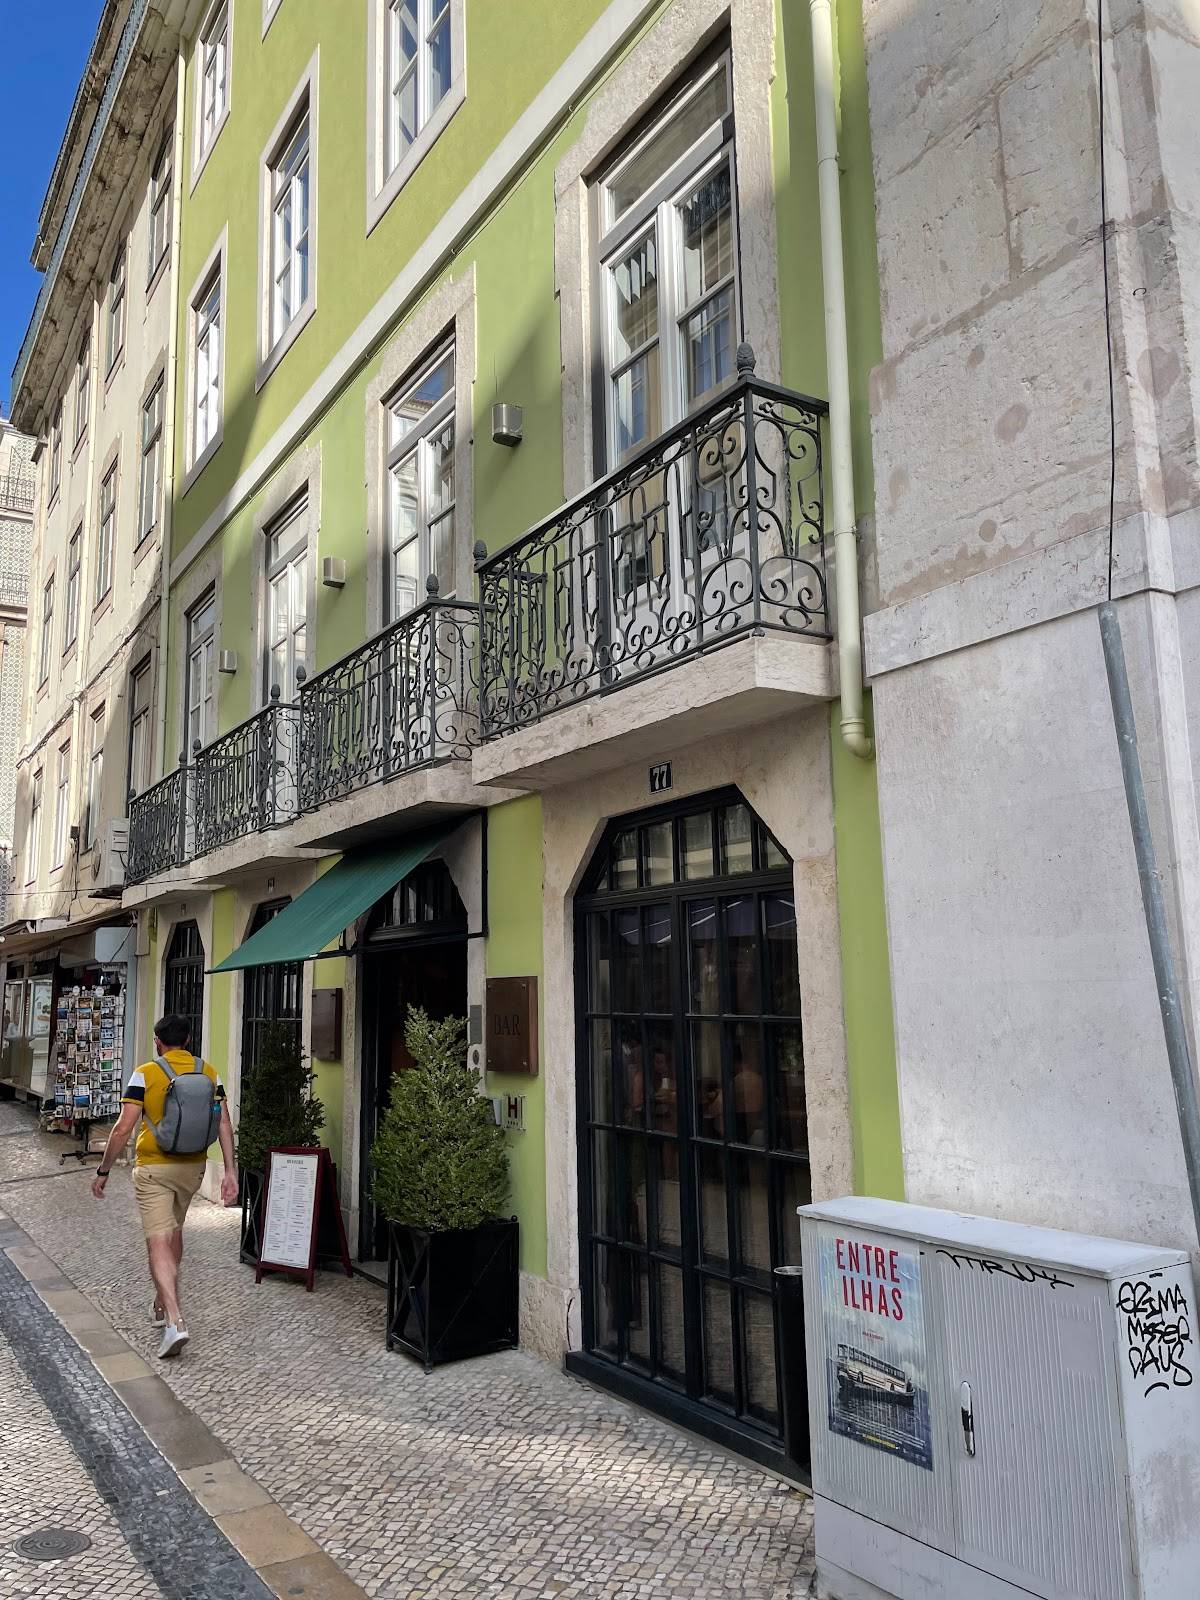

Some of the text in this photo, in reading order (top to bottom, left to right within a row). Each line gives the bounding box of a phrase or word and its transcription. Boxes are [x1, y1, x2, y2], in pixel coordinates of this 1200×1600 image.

[652, 764, 668, 790] 77
[493, 1014, 521, 1036] BAR
[507, 1096, 519, 1119] H
[835, 1238, 901, 1283] ENTRE
[842, 1275, 904, 1321] ILHAS
